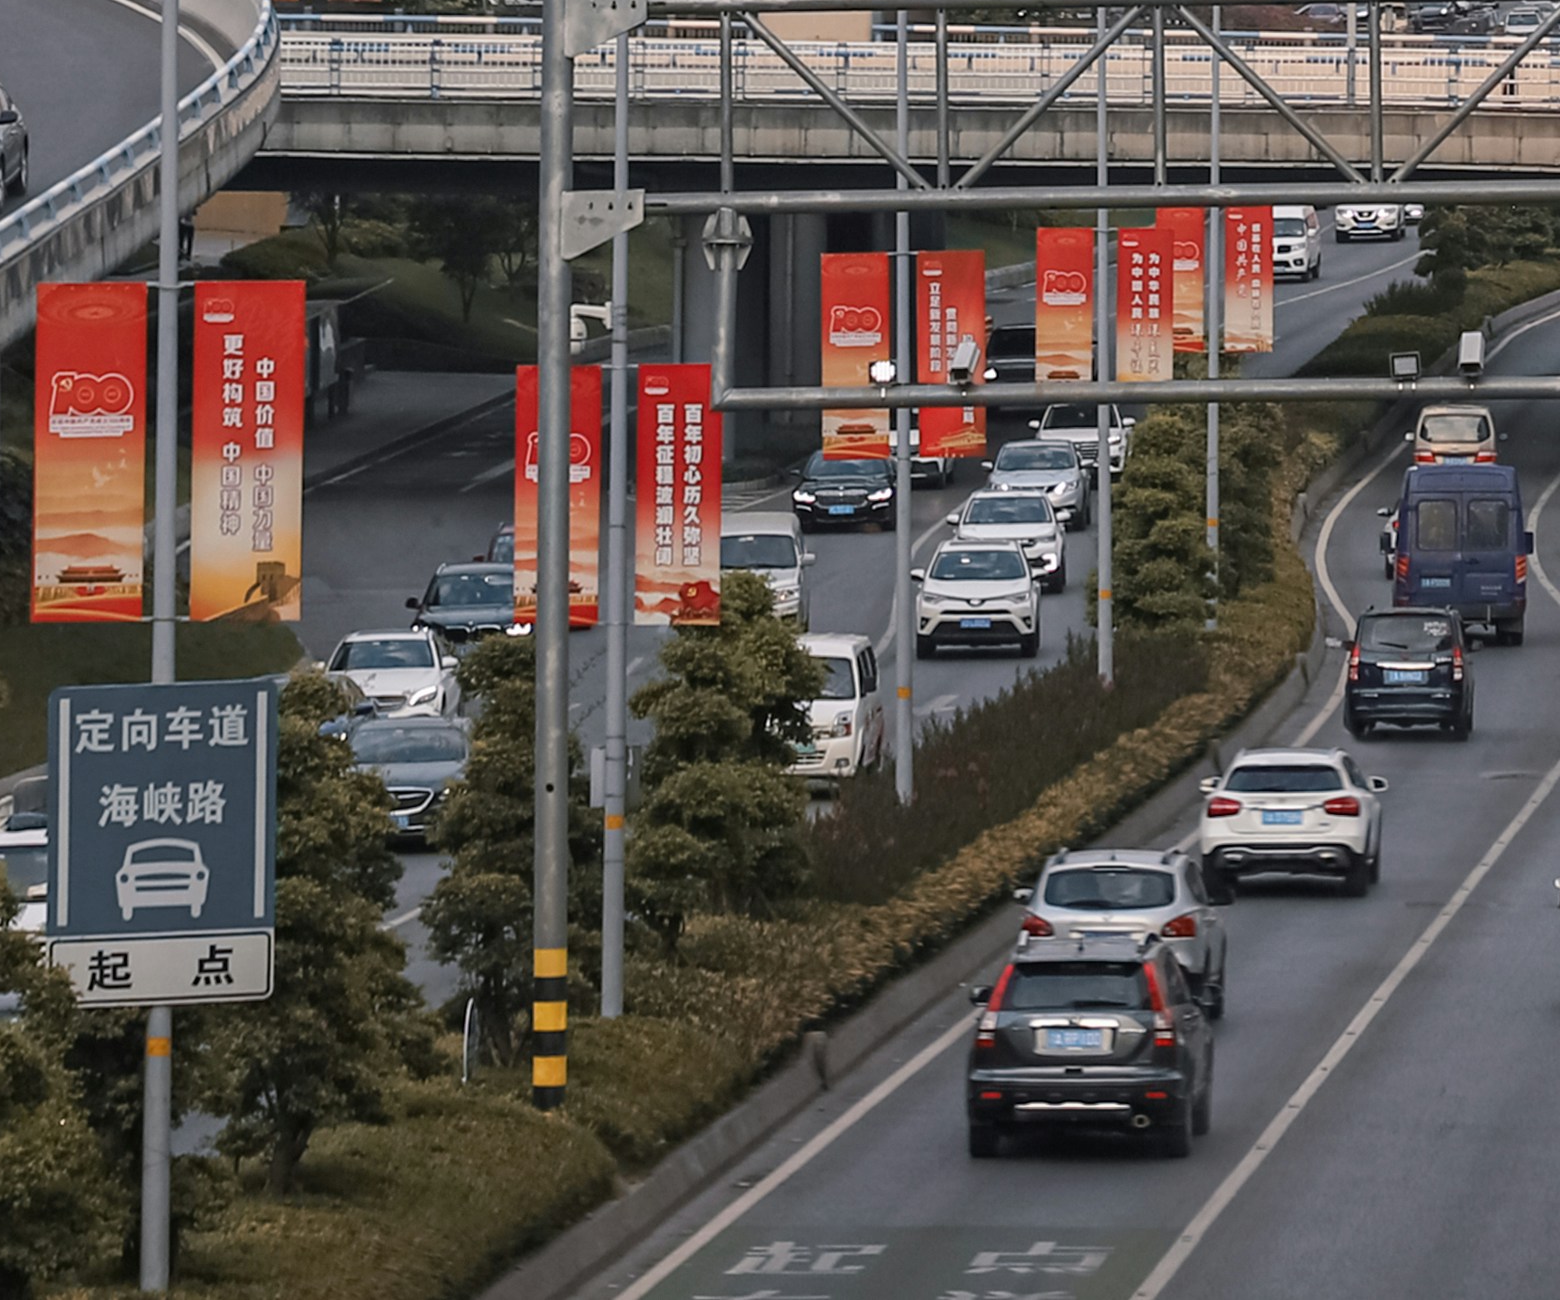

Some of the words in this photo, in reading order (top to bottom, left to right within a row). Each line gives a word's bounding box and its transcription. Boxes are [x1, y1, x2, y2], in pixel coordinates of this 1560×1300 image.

[49, 371, 134, 417] 100
[222, 334, 244, 428] 更好构筑
[255, 357, 275, 450] 中国价值
[220, 442, 240, 535] 中国精神
[252, 464, 274, 552] 中国力量
[655, 404, 675, 567] 百年征程波澜壮阔
[683, 404, 702, 567] 百年初心历久弥坚
[75, 704, 249, 753] 定向车道
[98, 780, 227, 828] 海峡路
[88, 945, 234, 991] 起点
